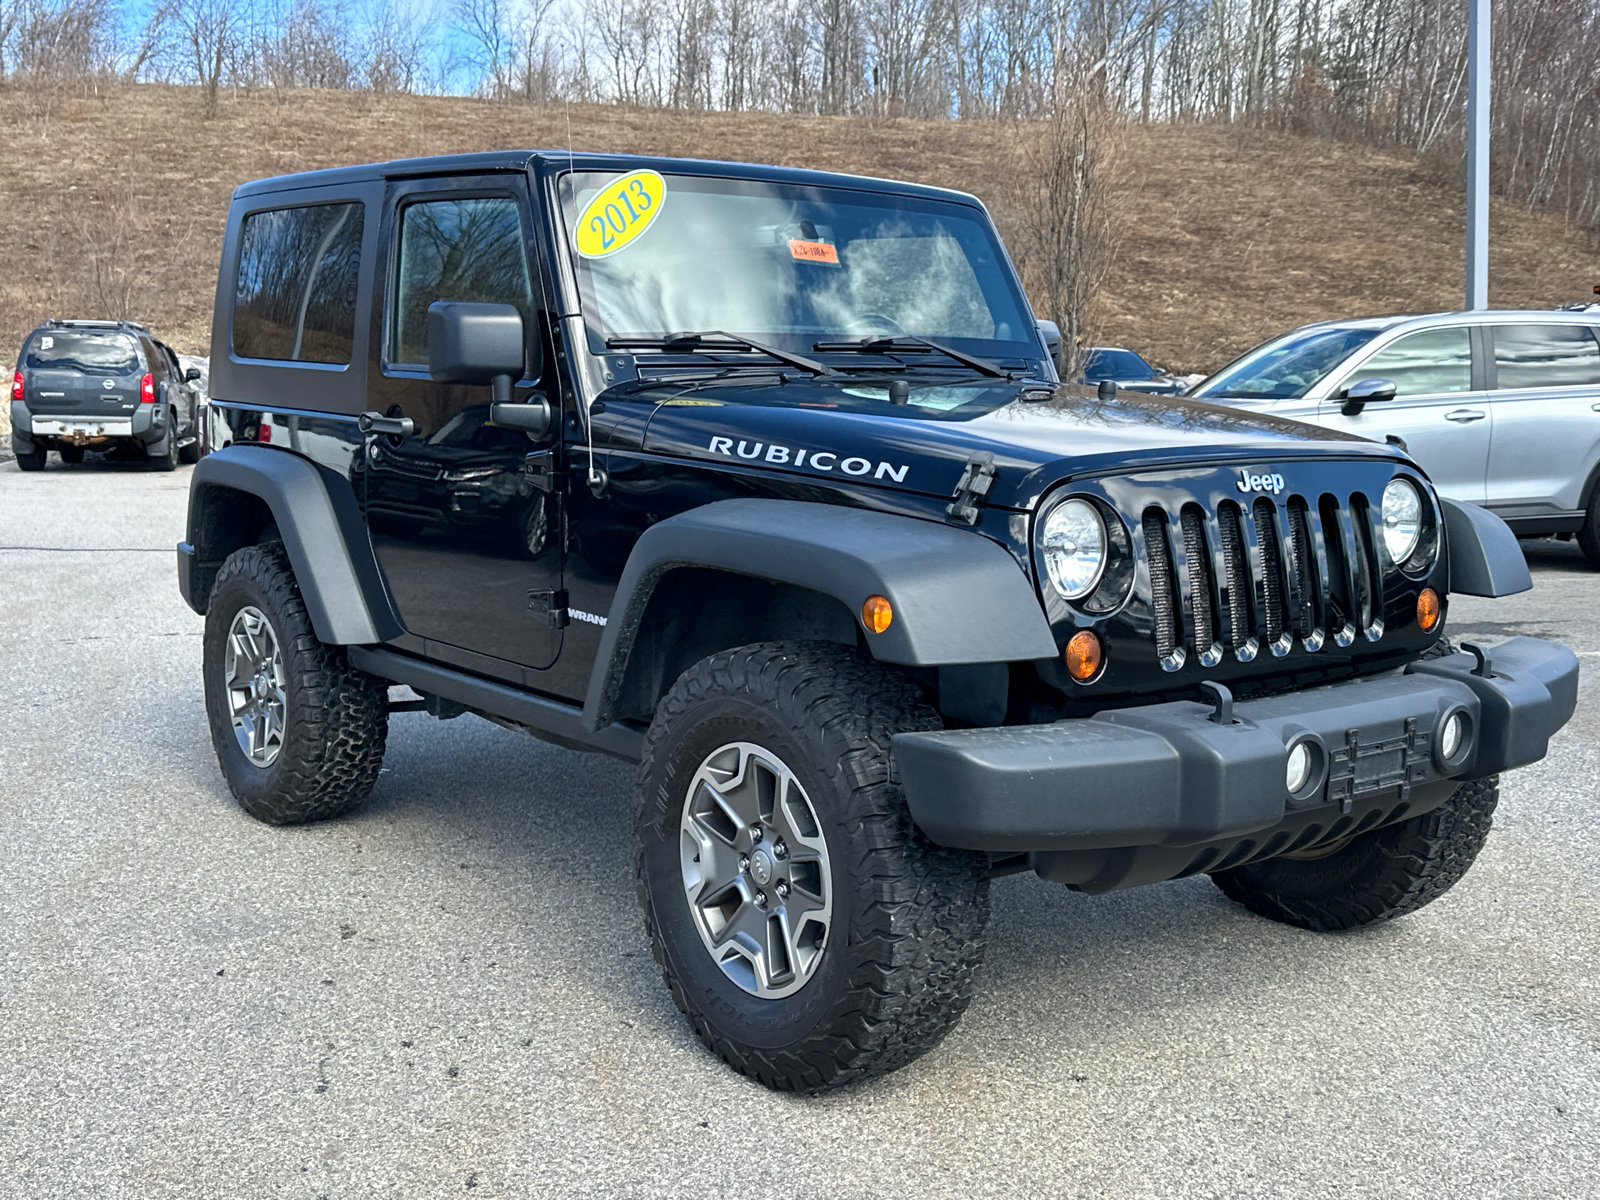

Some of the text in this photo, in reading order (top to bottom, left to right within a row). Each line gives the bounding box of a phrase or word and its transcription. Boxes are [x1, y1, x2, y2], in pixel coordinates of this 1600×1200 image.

[589, 178, 652, 250] 2013
[708, 435, 910, 483] RUBICON
[1236, 469, 1285, 495] Jeep
